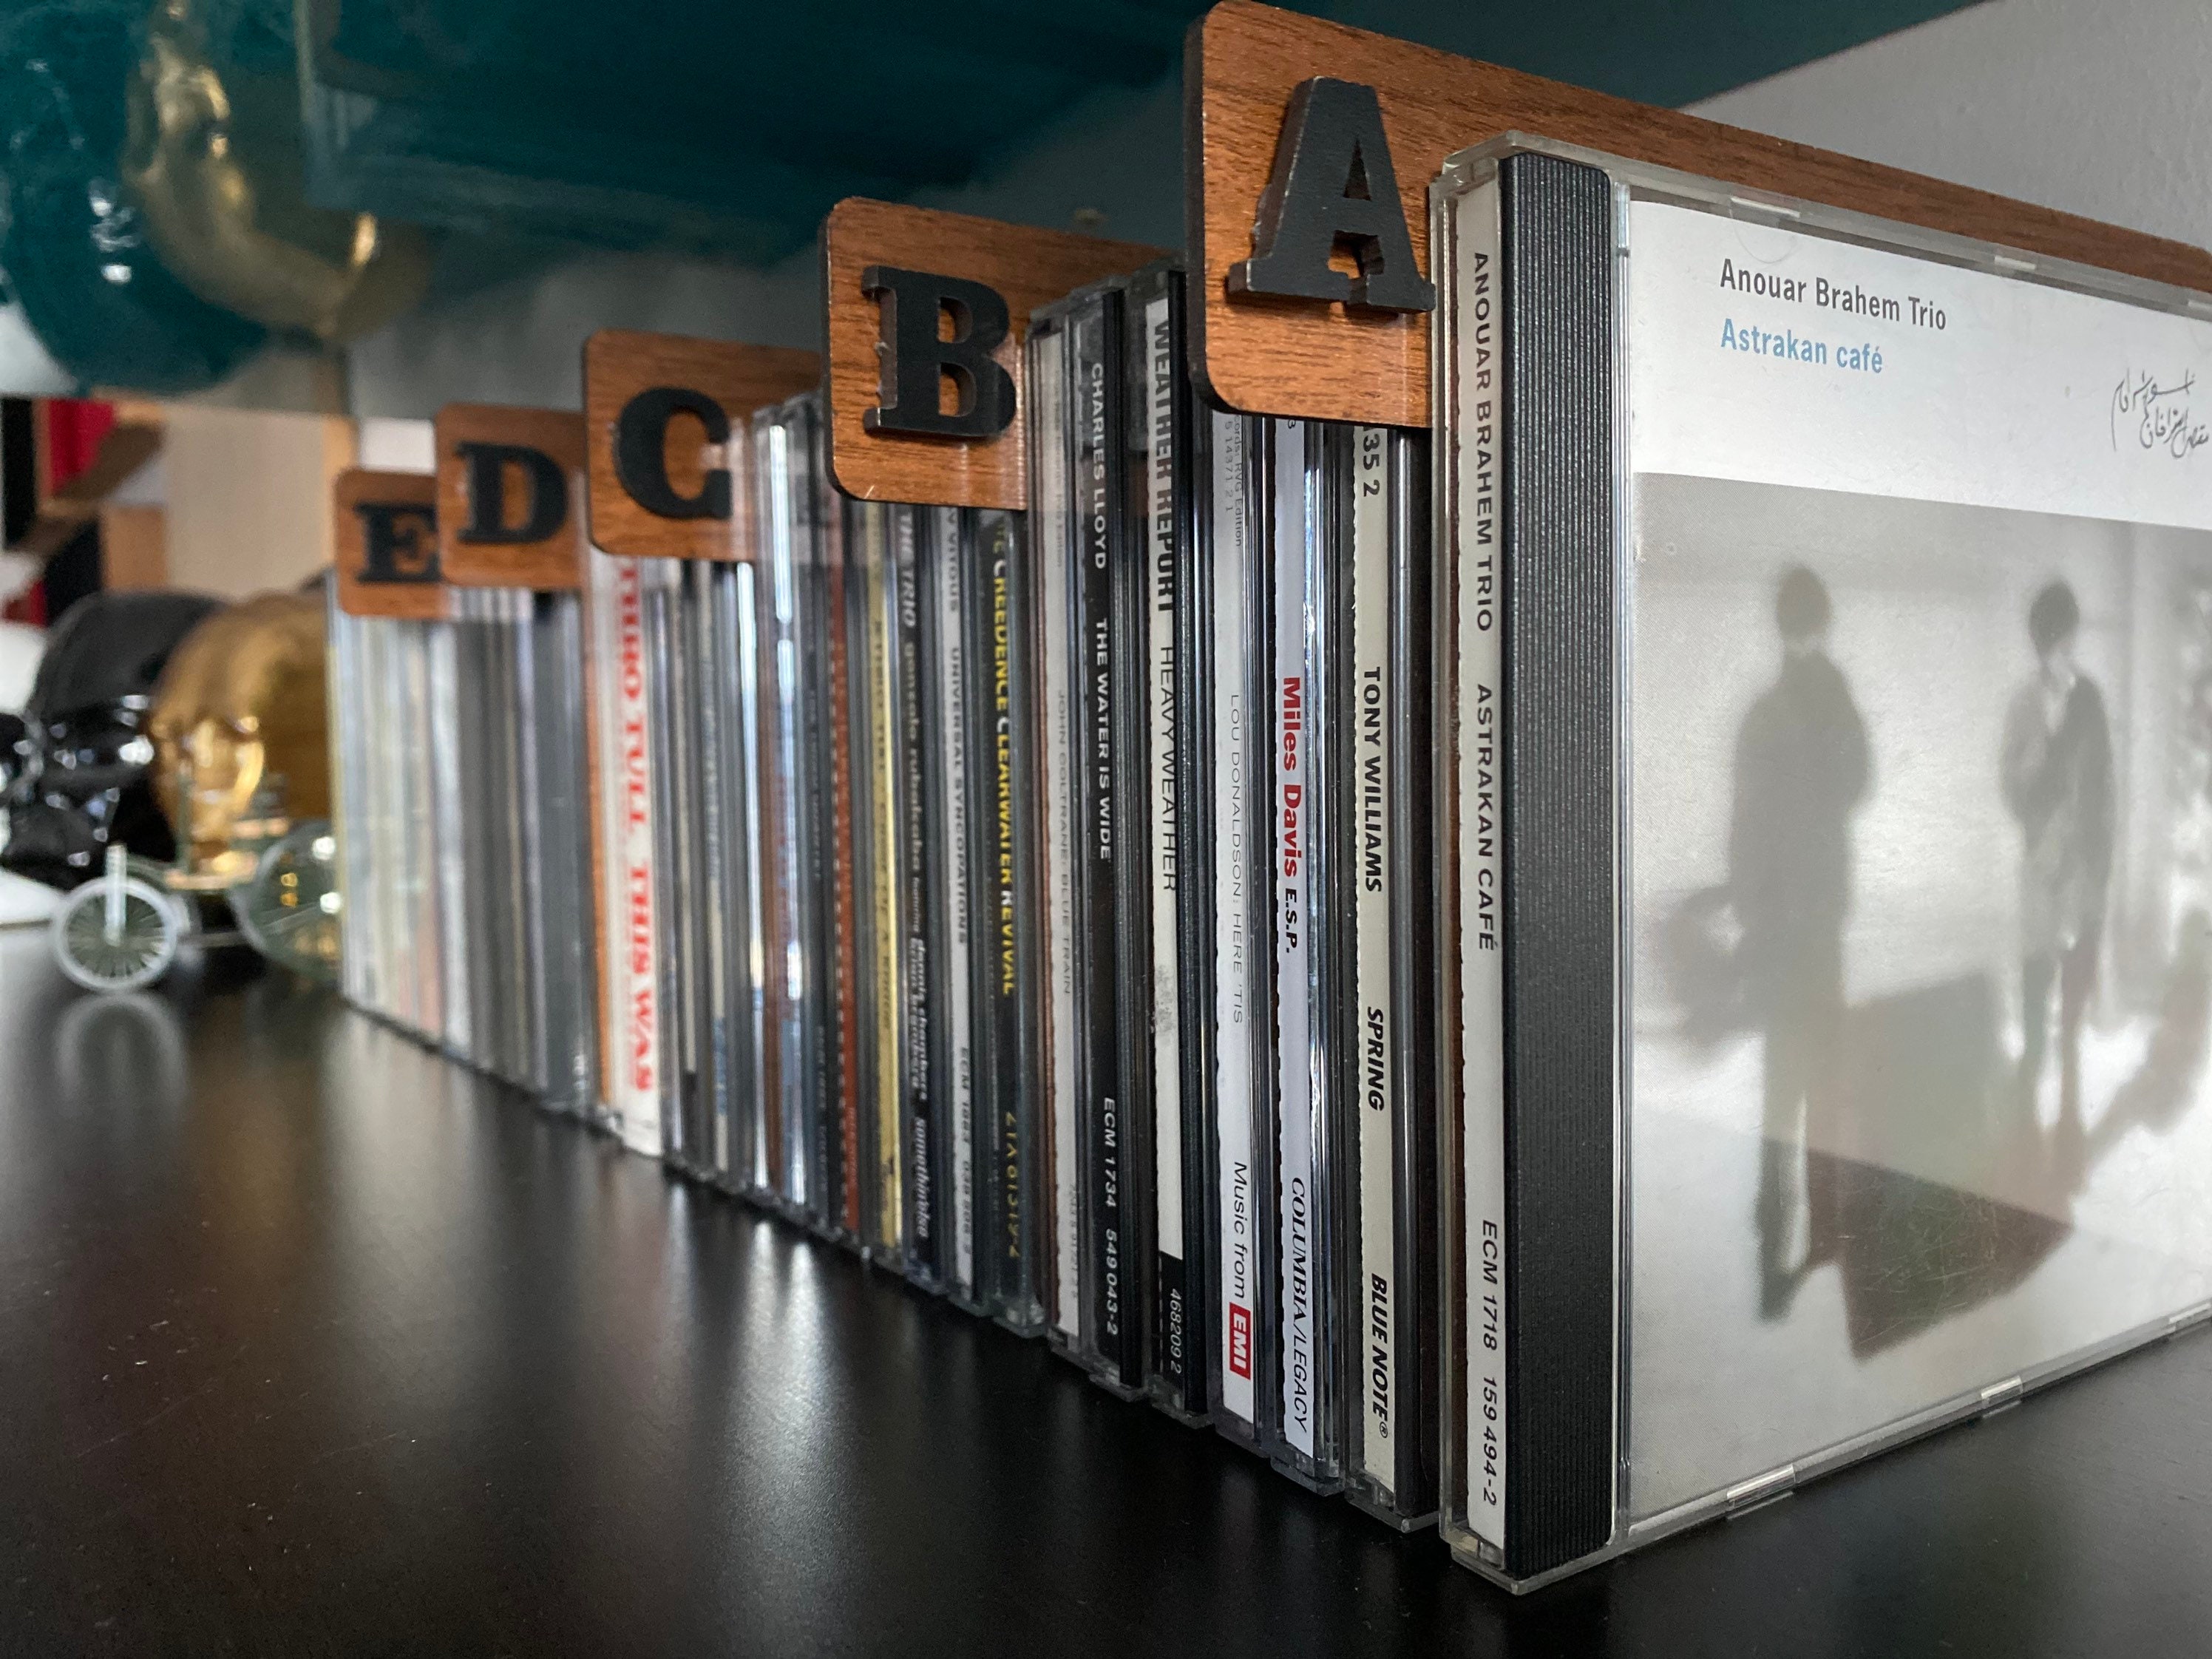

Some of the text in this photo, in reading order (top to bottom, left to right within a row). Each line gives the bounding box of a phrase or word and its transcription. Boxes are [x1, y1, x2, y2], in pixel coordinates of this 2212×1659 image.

[1229, 76, 1436, 313] A
[1720, 259, 1947, 330] Anouar Brahem Trio
[863, 265, 1017, 438] B
[1720, 318, 1883, 373] Astrakan café
[614, 387, 733, 521] C
[1091, 363, 1105, 480] CHARLES
[1363, 426, 1380, 470] 35
[456, 441, 568, 545] D
[1093, 488, 1106, 569] LLOYD
[1235, 498, 1243, 546] Edition
[1363, 479, 1380, 497] 2
[354, 501, 444, 583] E
[901, 567, 916, 628] TRIO
[993, 559, 1009, 711] CREEDENCE
[1096, 618, 1108, 665] THE
[1058, 690, 1067, 744] JOHN
[1097, 674, 1109, 759] WATER
[1231, 695, 1240, 741] LOU
[1283, 677, 1301, 771] Miles
[1364, 666, 1381, 747] TONY
[996, 716, 1013, 884] CLEARWATER
[1099, 767, 1110, 789] IS
[1100, 797, 1110, 859] WIDE
[1156, 320, 1181, 1374] WEATHER REPORT HEAVY WEATHER 468209 2
[1232, 753, 1242, 903] DONALDSON:
[1284, 784, 1302, 877] Davis
[1365, 756, 1382, 892] WILLIAMS
[1061, 874, 1071, 926] BLUE
[1474, 252, 1498, 1506] ANOUAR BRAHEM TRIO ASTRAKAN CAFÉ ECM 1718 159 494-2
[1001, 889, 1015, 997] REVIVAL
[1233, 914, 1243, 974] HERE
[1286, 888, 1297, 953] E.S.P.
[1368, 1006, 1385, 1111] SPRING
[1105, 1097, 1116, 1147] ECM
[1105, 1157, 1116, 1207] 1734
[1106, 1228, 1117, 1269] 549
[1233, 1161, 1247, 1368] Music from EMI
[1371, 1272, 1388, 1343] BLUE
